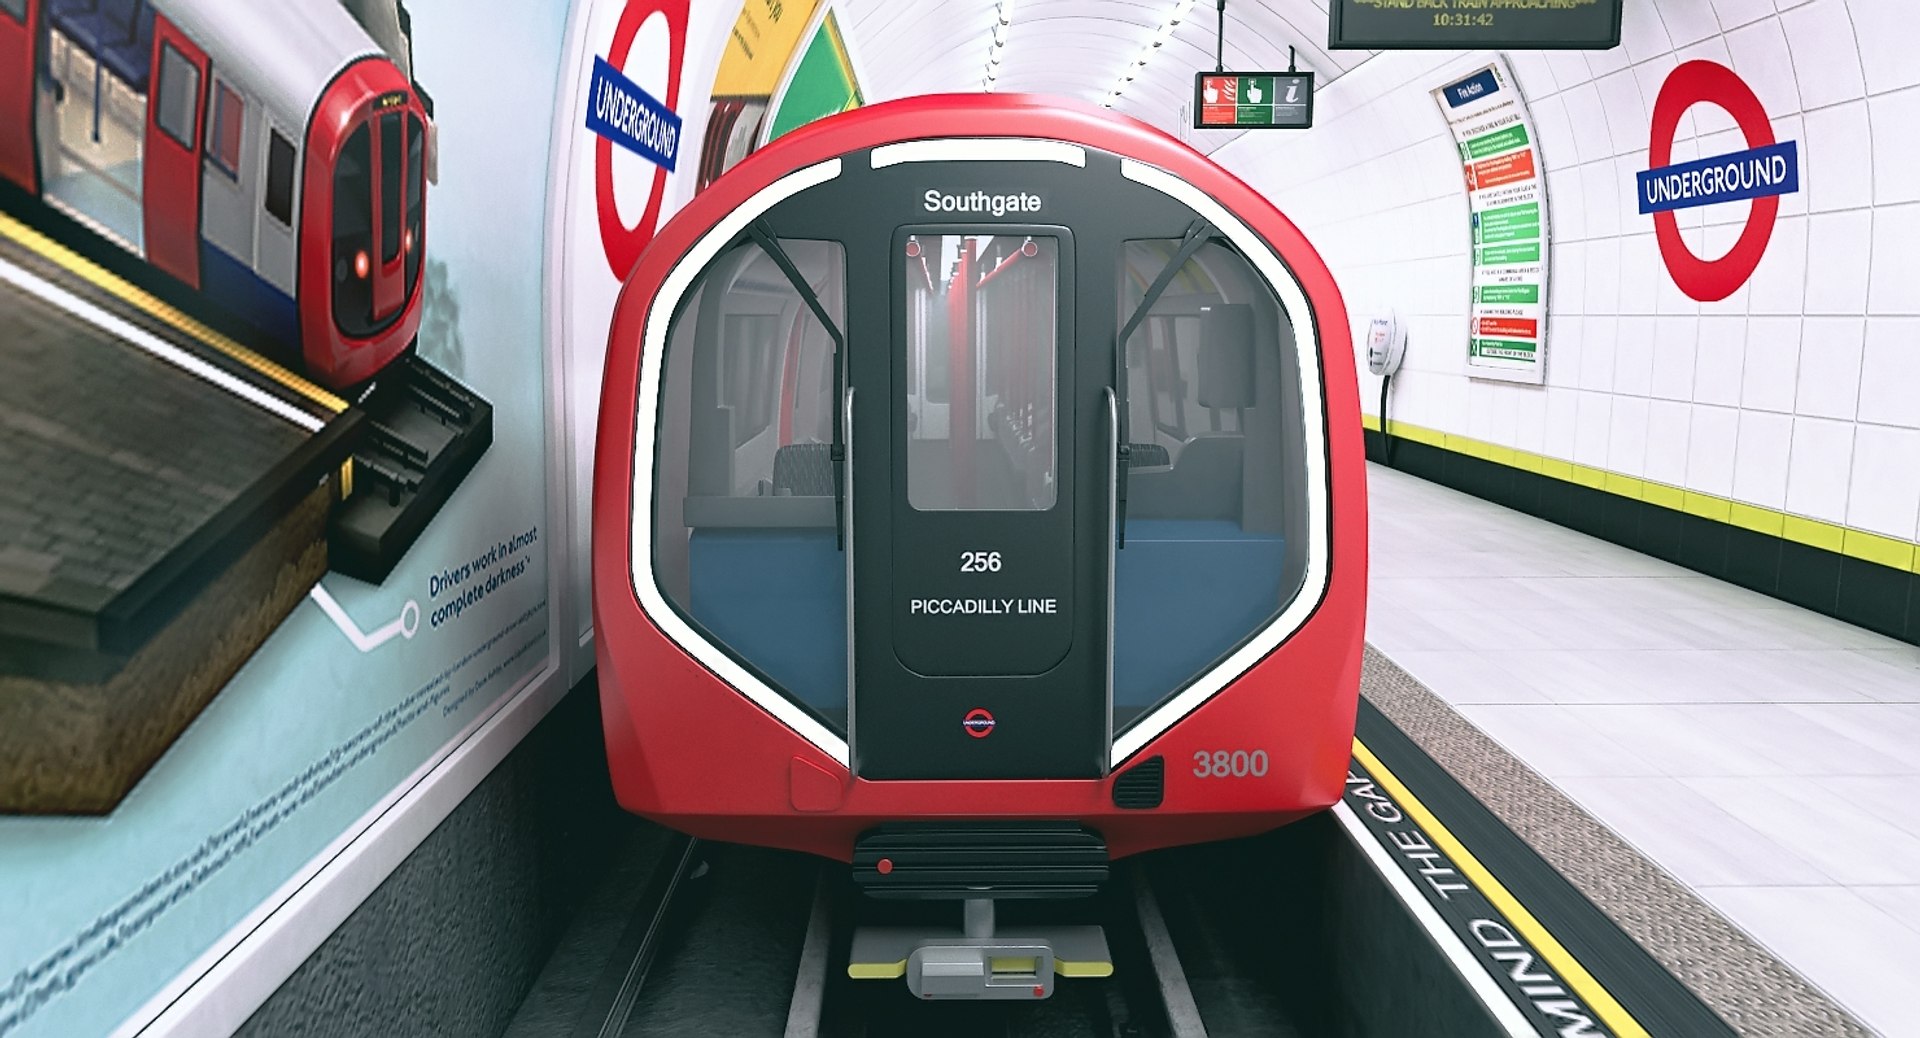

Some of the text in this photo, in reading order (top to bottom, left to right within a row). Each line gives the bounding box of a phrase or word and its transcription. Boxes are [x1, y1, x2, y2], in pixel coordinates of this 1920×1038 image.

[1433, 13, 1494, 26] 10:31:42
[596, 76, 676, 160] UNDERGROUND
[1646, 154, 1787, 204] UNDERGROUND
[924, 189, 1042, 217] Southgate
[430, 525, 537, 597] Drivers work in almost
[960, 551, 1002, 573] 256
[431, 585, 484, 627] complete
[911, 599, 1057, 615] PICCADILLY LINE
[1193, 749, 1269, 778] 3800
[1387, 830, 1471, 900] THE
[1468, 918, 1607, 1038] MIND
